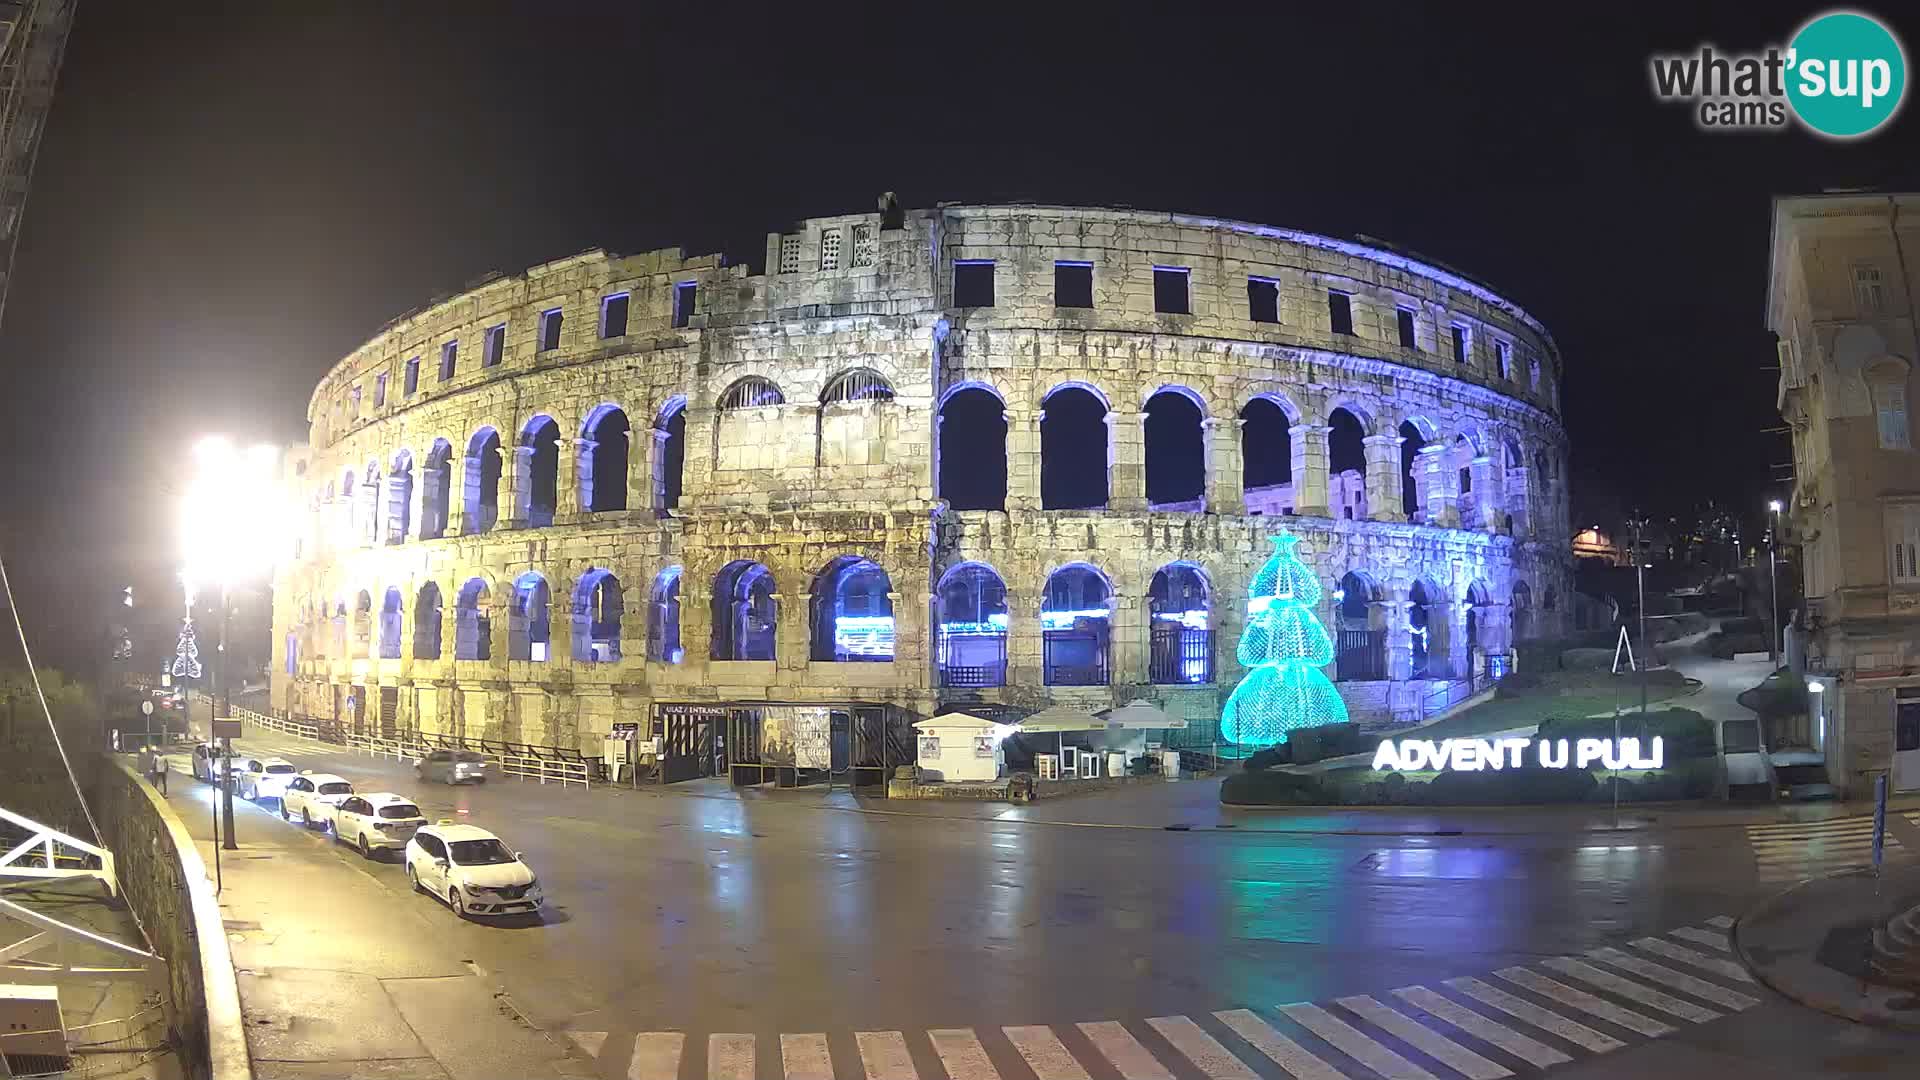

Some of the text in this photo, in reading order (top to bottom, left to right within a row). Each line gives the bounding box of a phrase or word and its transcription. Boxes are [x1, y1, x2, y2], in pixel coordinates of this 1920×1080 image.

[1372, 736, 1664, 771] ADVENT U PULI
